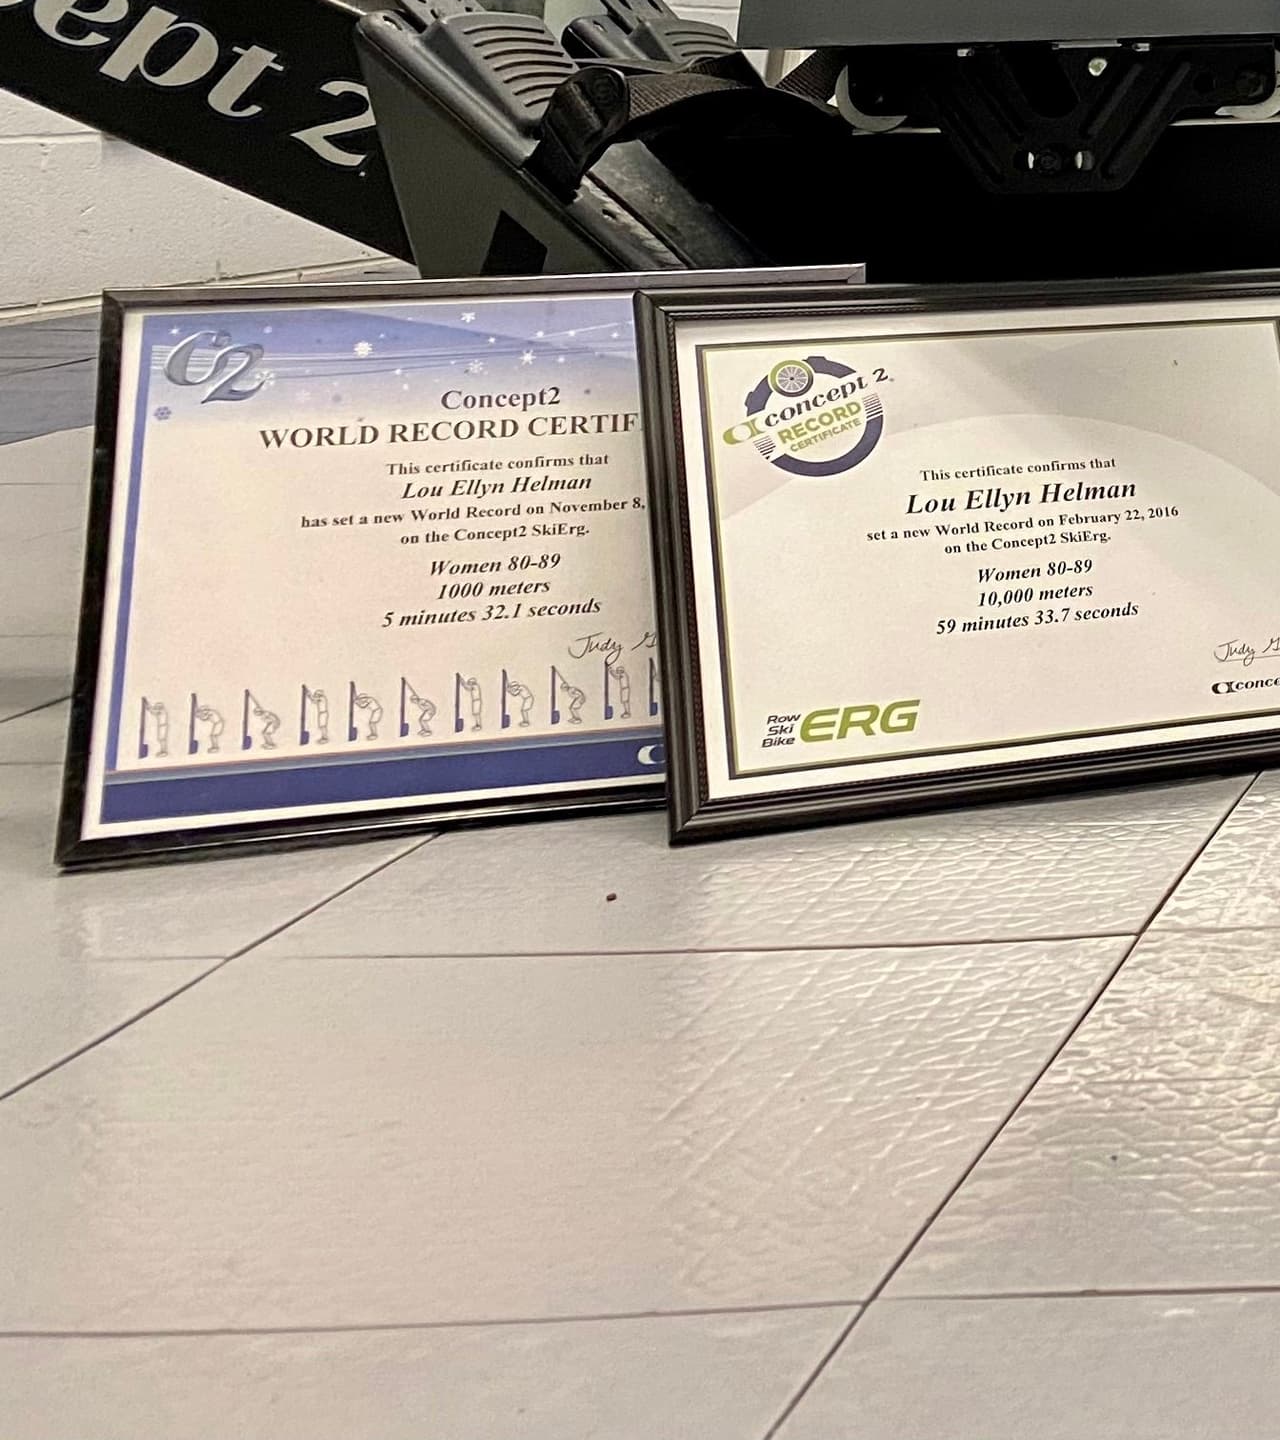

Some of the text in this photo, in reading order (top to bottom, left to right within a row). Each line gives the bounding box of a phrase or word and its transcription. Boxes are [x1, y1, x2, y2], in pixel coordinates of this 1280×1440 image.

[291, 80, 379, 168] 2
[440, 385, 561, 412] Concept2
[764, 367, 889, 428] concept 2
[259, 424, 380, 449] WORLD
[389, 418, 520, 443] RECORD
[777, 400, 862, 444] RECORD
[789, 417, 862, 453] CERTIFICATE
[385, 452, 609, 475] This certificate confirms that
[919, 457, 1116, 481] This certificate confirms that
[401, 474, 592, 500] Lou Ellyn Helman
[905, 481, 1136, 514] Lou Ellyn Helman
[400, 522, 590, 544] on the Concept2 SkiErg.
[866, 505, 1179, 541] set a new World Record on February 22, 2016
[944, 529, 1112, 554] on the Concept2 SkiErg.
[430, 552, 561, 576] Women 80-89
[978, 558, 1093, 583] Women 80-89
[437, 580, 551, 599] 1000 meters
[978, 585, 1094, 608] 10,000 meters
[381, 596, 601, 627] 5 minutes 32.1 seconds
[936, 600, 1139, 635] 59 minutes 33.7 seconds
[766, 713, 802, 725] Row
[767, 723, 795, 737] Ski
[800, 699, 921, 743] ERG
[761, 736, 796, 749] Bike
